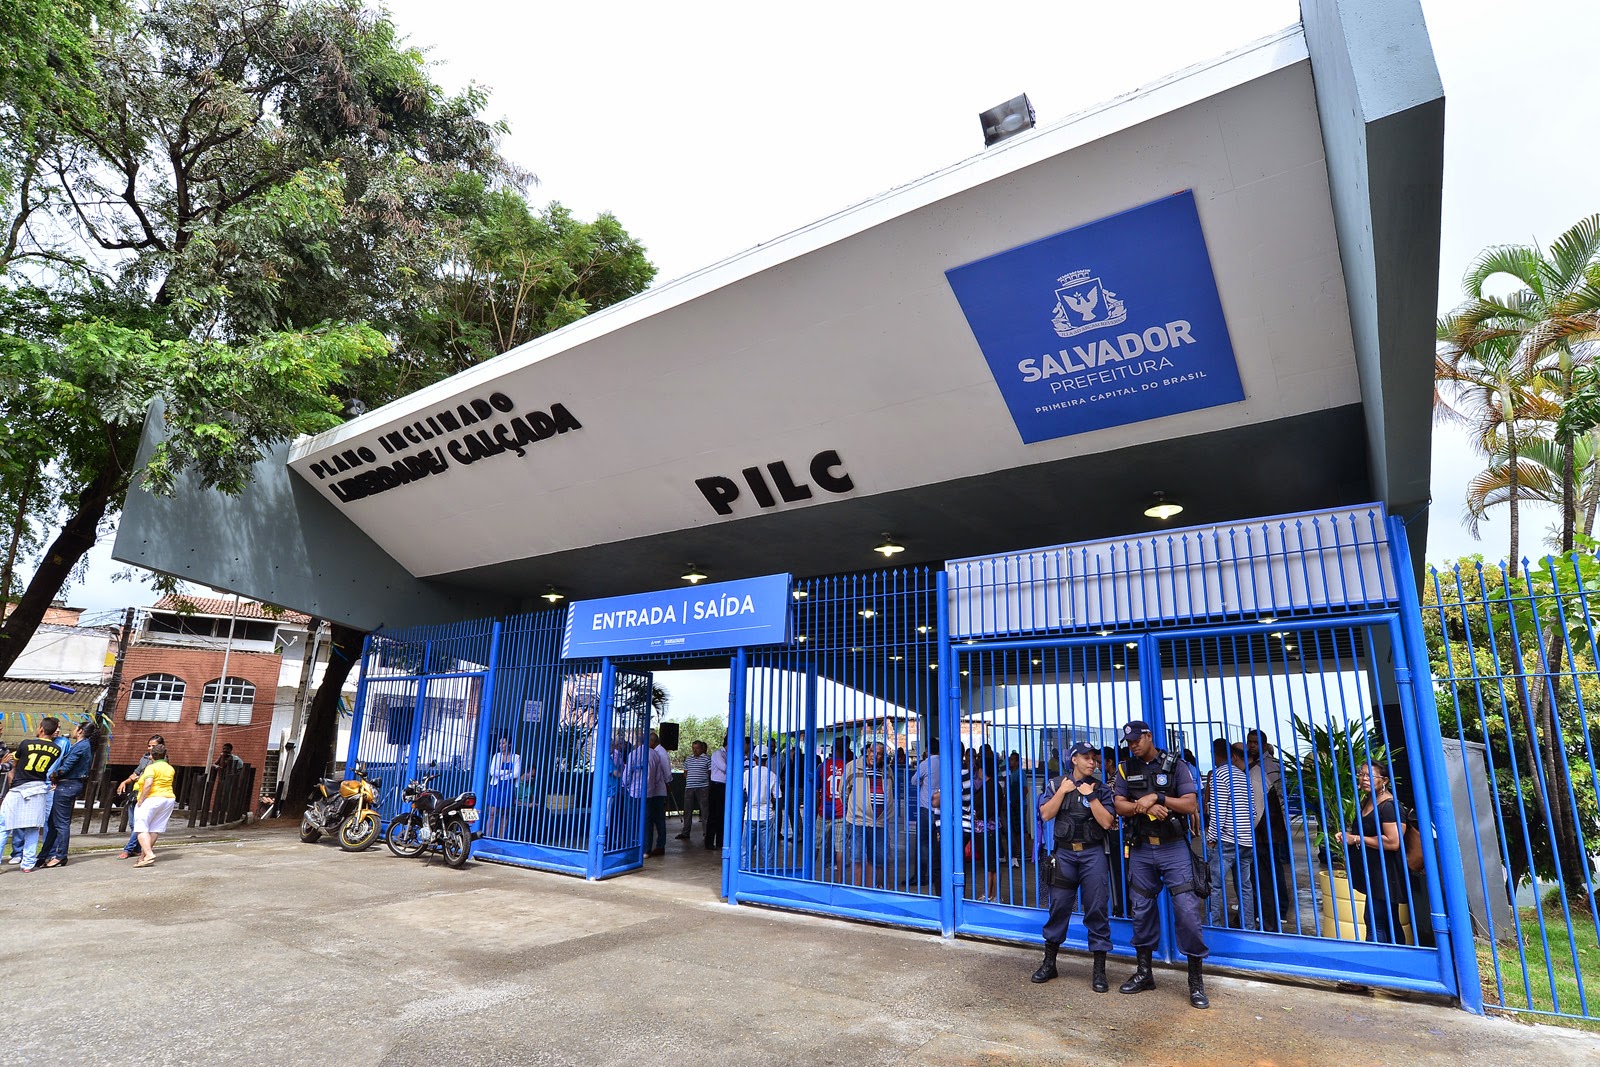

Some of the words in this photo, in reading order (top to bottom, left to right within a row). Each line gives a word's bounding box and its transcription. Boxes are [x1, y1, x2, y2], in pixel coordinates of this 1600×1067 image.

[1018, 319, 1197, 383] SALVADOR
[1035, 397, 1087, 414] PRIMEIRA
[1090, 386, 1138, 402] CAPITAL
[1141, 381, 1158, 392] DO
[1163, 371, 1207, 386] BRASIL
[1050, 356, 1175, 394] PREFEITURA
[309, 446, 377, 480] PLANO
[377, 392, 514, 454] INCLINADO
[447, 402, 583, 458] CALÇADA
[694, 449, 855, 516] PILC
[592, 604, 677, 631] ENTRADA
[693, 593, 755, 620] SAÍDA
[24, 752, 51, 773] 10
[27, 744, 59, 756] BRASIL
